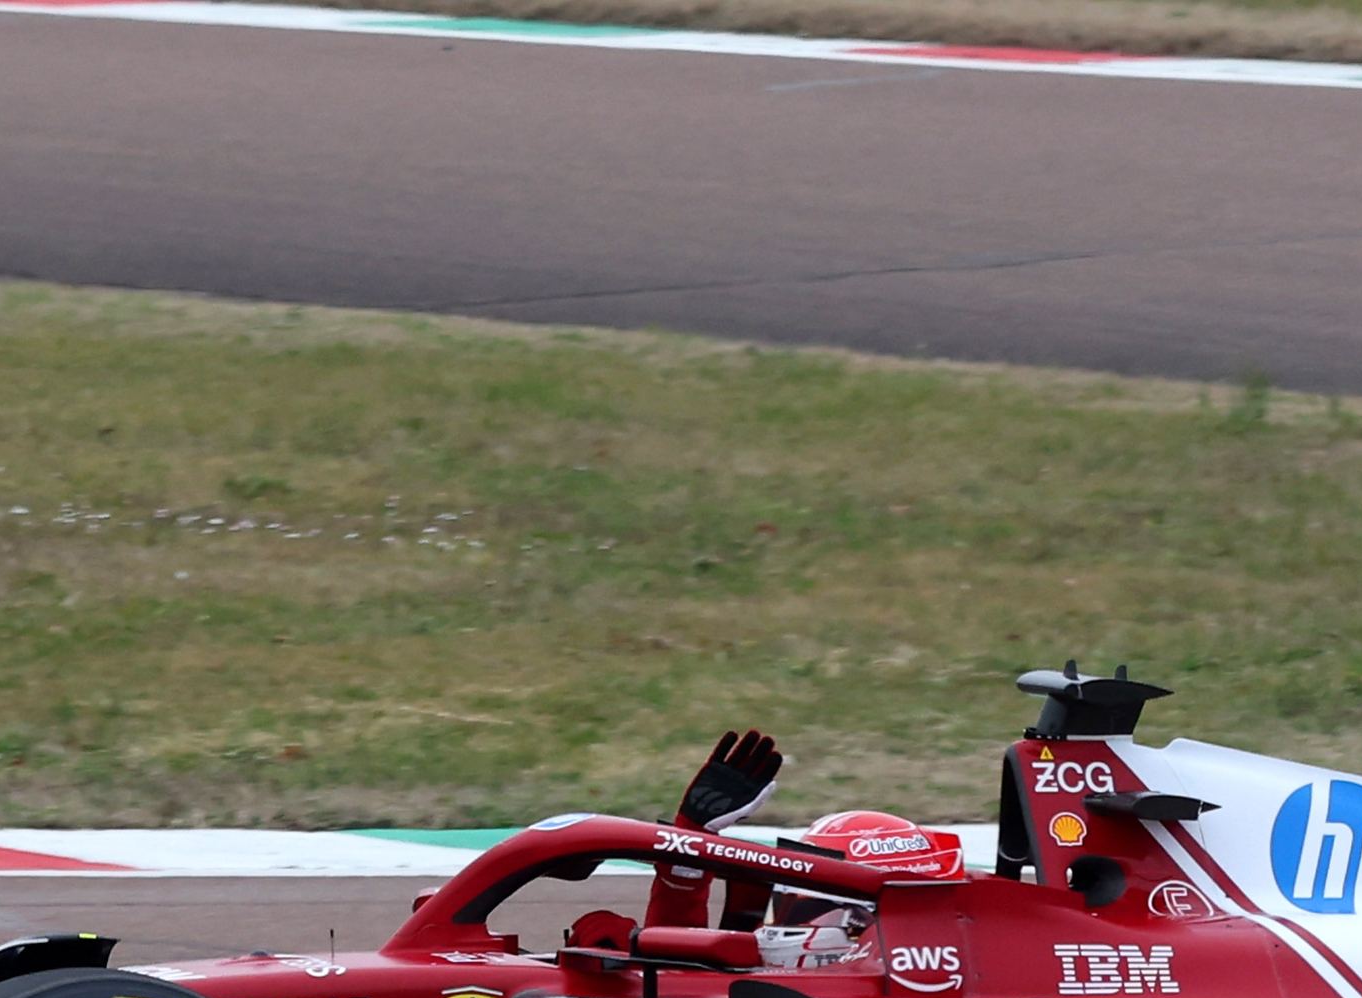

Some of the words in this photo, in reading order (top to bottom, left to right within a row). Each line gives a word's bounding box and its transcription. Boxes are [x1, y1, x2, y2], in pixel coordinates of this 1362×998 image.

[653, 830, 704, 857] DXC
[705, 841, 815, 874] TECHNOLOGY
[870, 835, 930, 854] UniCredit
[891, 944, 961, 973] aws
[1053, 944, 1181, 995] IBM
